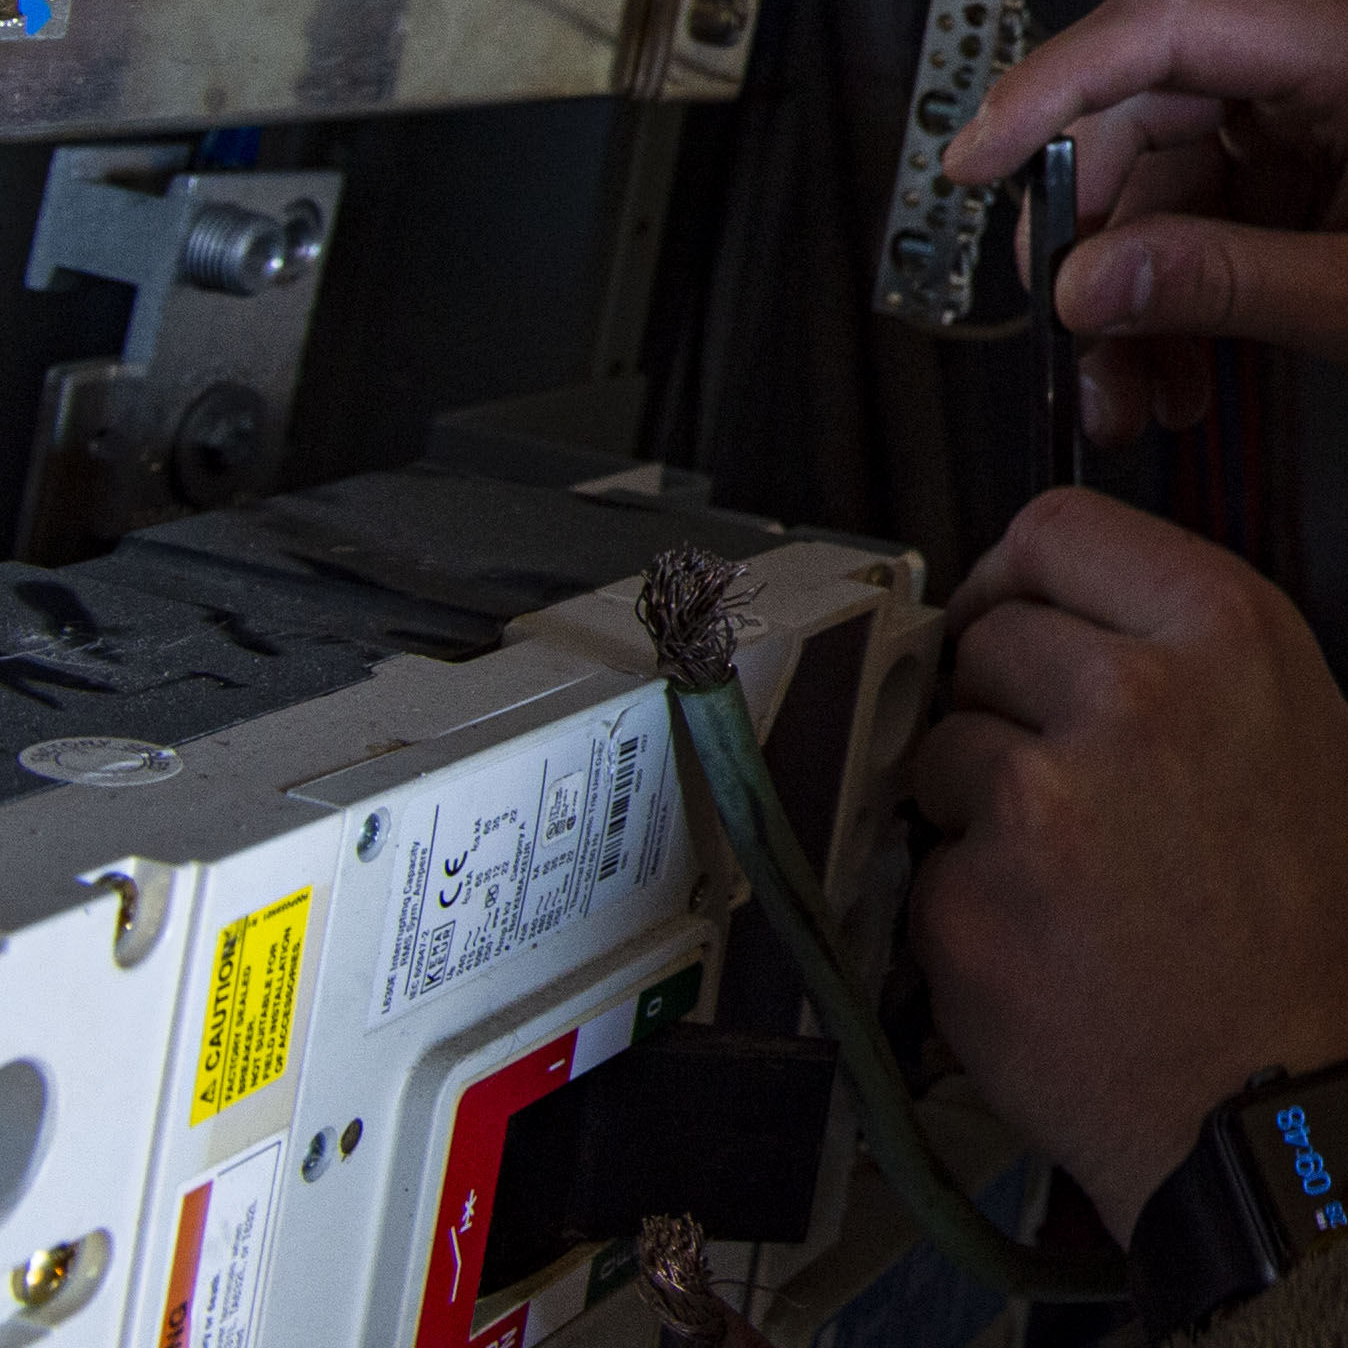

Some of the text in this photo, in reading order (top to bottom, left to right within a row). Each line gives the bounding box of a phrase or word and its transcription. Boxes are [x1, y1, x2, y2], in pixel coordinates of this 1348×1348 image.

[388, 895, 412, 972] Interrupting
[402, 838, 422, 895] Capacity
[398, 933, 413, 967] RMS
[411, 846, 428, 898] Ampere
[508, 831, 525, 882] Category
[569, 865, 584, 909] Thermal
[577, 814, 594, 866] Magnetic
[203, 935, 237, 1074] CAUTION
[223, 963, 252, 1102] FACTORY SEALED
[249, 941, 278, 1088] NOT SUITABLE FOR
[261, 925, 292, 1081] FIELD INSTALLATION
[409, 979, 420, 1000] IEC
[273, 1052, 284, 1074] OF
